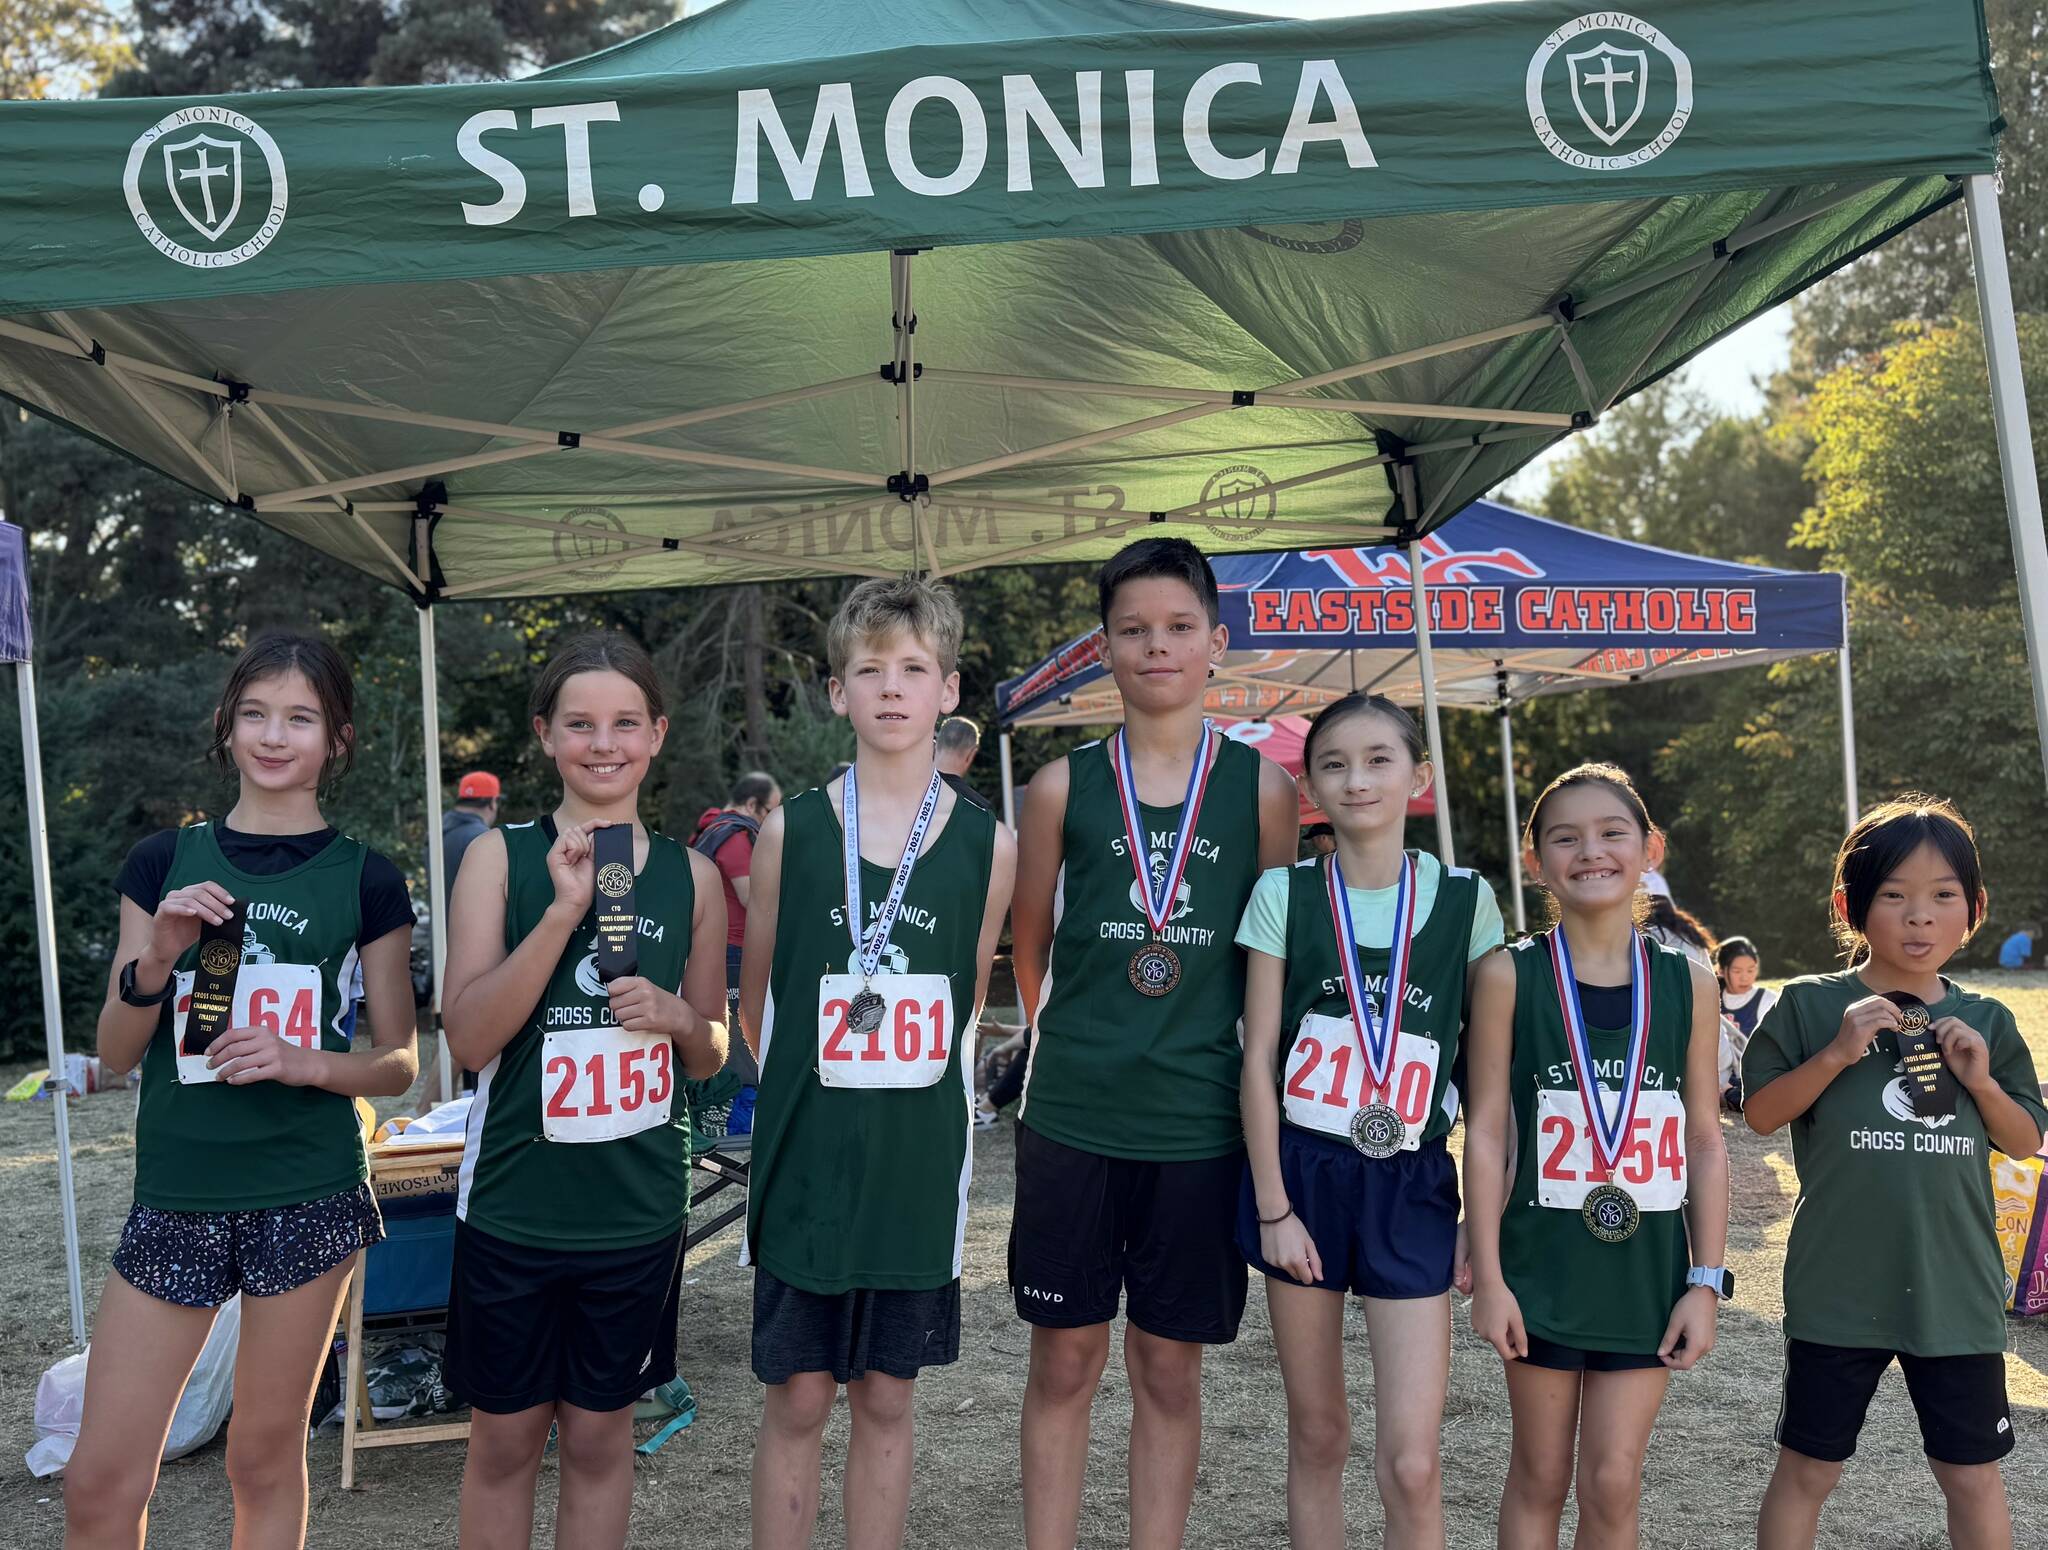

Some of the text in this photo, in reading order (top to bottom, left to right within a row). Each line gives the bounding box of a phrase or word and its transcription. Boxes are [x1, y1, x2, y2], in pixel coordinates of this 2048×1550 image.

[1545, 13, 1658, 49] ST. MONICA
[175, 107, 254, 136] MONICA
[456, 59, 1380, 226] ST. MONICA
[1534, 107, 1689, 169] CATHOLIC SCHOOL
[136, 202, 285, 266] CATHOLIC SCHOOL
[1516, 587, 1756, 635] CATHOLIC
[871, 932, 886, 956] 2025
[884, 898, 898, 922] 2025
[897, 863, 910, 888] 2025
[908, 830, 921, 854] 2025
[920, 801, 932, 823] 2025
[1100, 921, 1146, 941] CROSS
[546, 1007, 592, 1025] CROSS
[546, 1043, 671, 1118] 2153
[1850, 1130, 1975, 1156] CROSS COUNTRY
